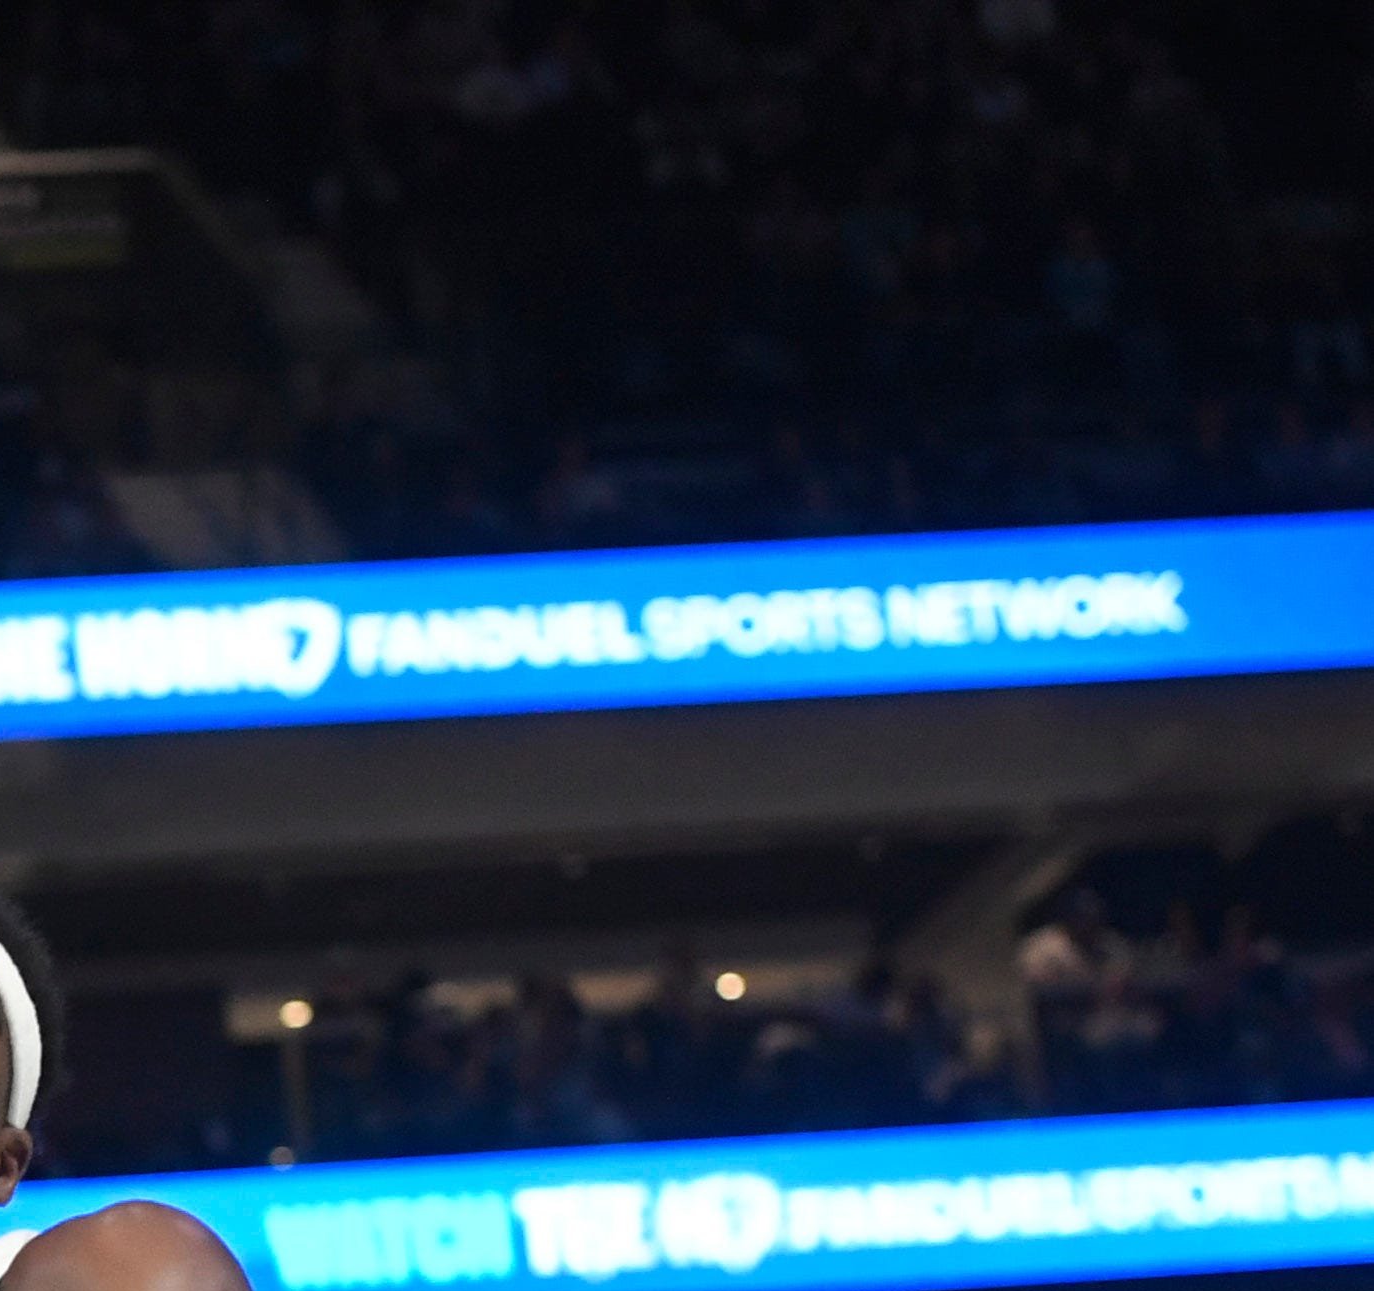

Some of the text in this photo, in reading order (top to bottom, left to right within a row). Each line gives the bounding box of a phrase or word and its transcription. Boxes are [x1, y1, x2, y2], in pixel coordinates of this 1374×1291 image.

[347, 601, 643, 676] FANDUEL
[643, 586, 883, 660] SPORTS
[887, 570, 1187, 647] NETWORK
